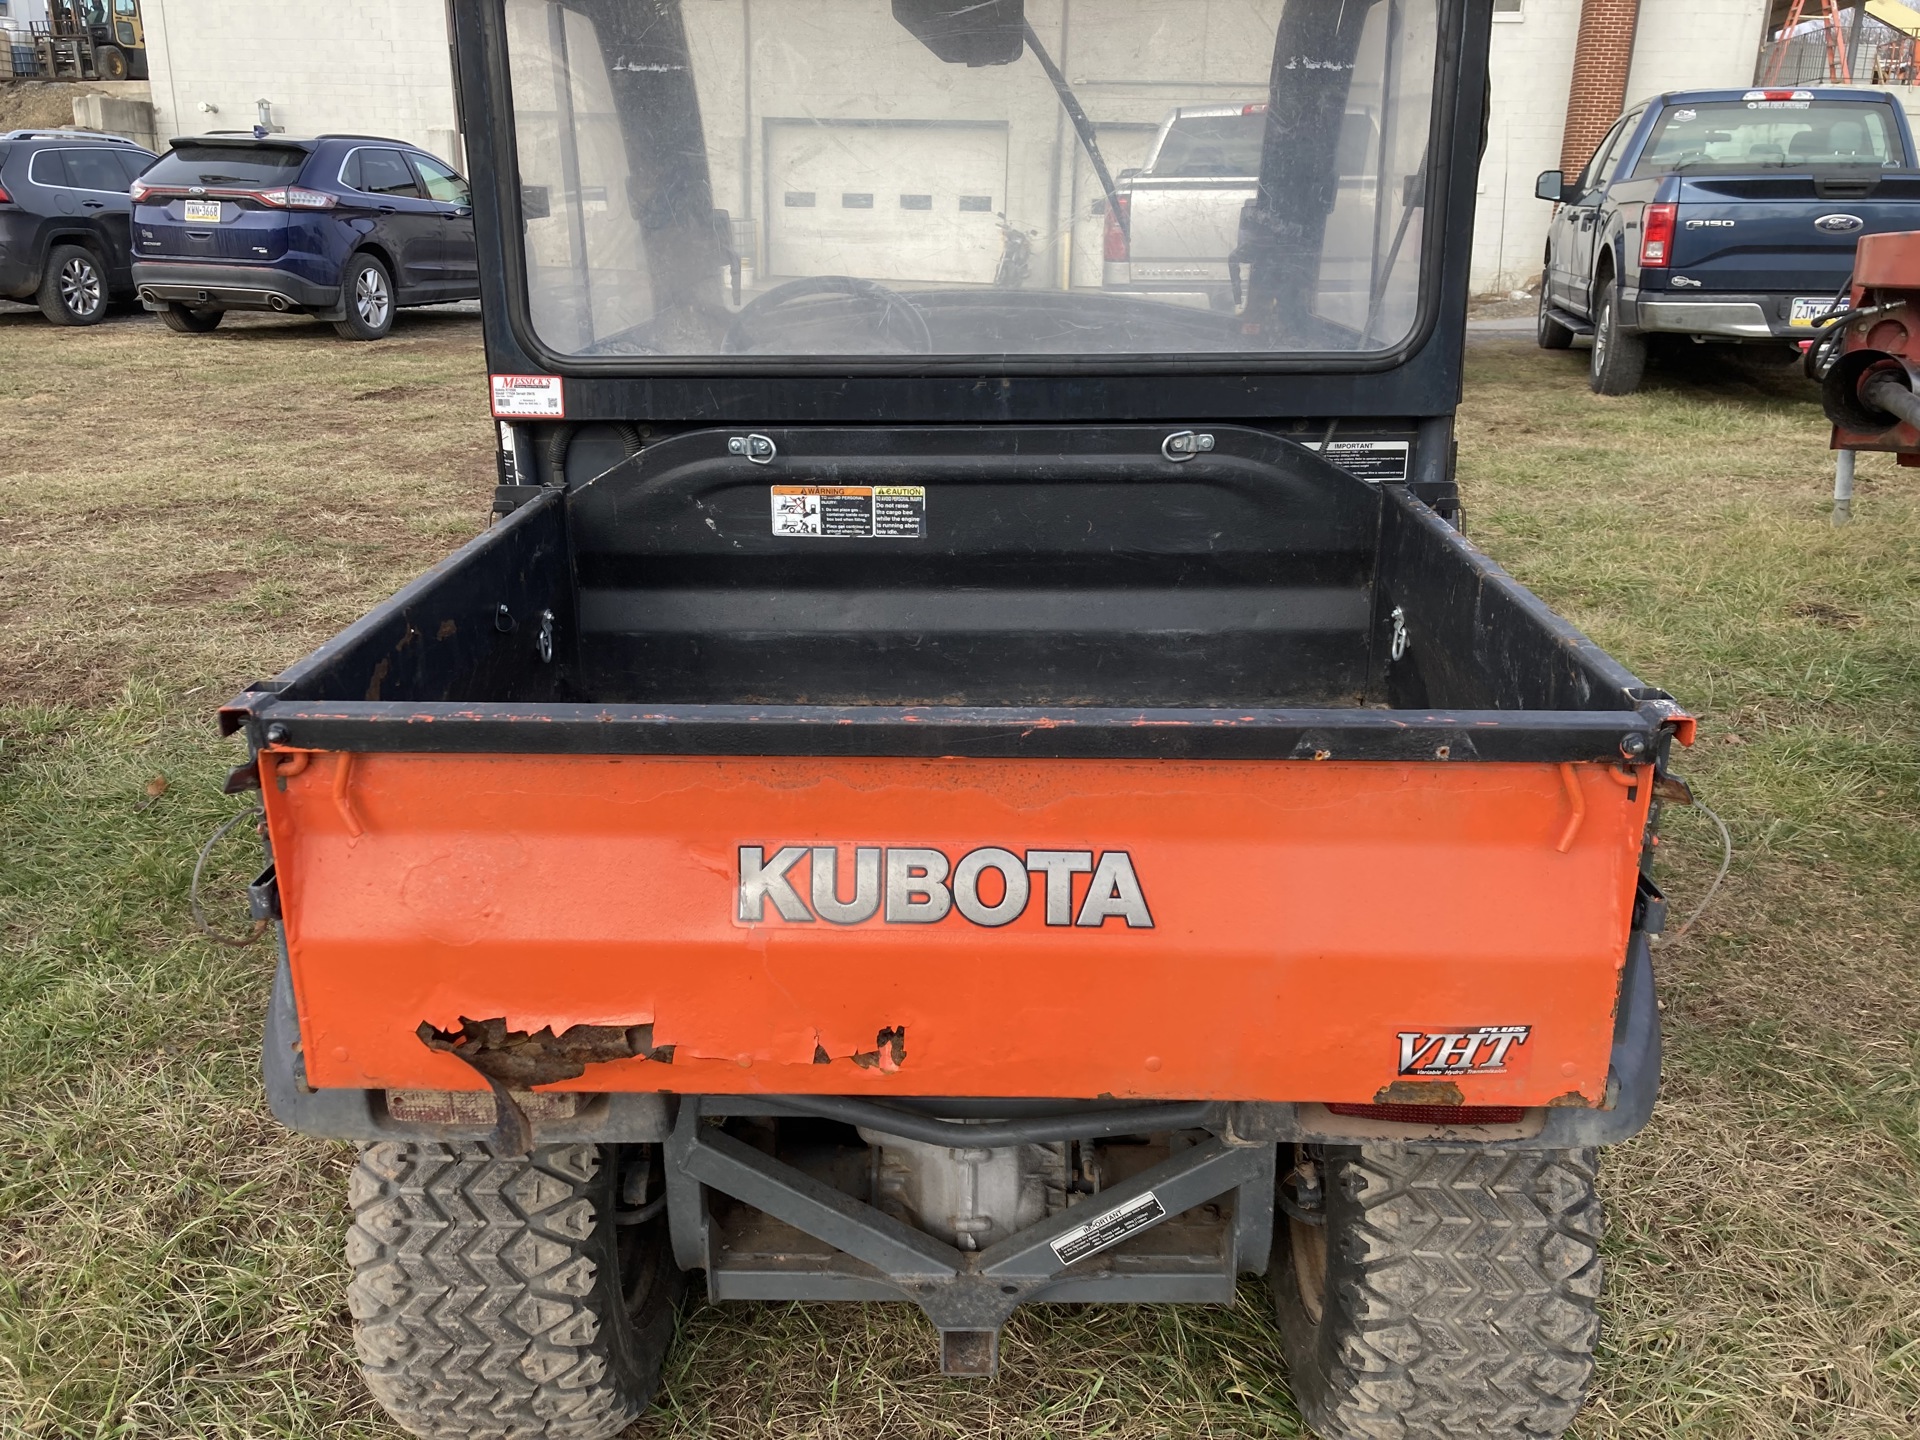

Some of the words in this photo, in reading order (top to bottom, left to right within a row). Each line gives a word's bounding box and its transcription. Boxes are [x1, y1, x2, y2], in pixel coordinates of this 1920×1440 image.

[502, 378, 551, 388] MESSICK'S
[738, 846, 1156, 928] KUBOTA
[1397, 1032, 1528, 1073] VHT
